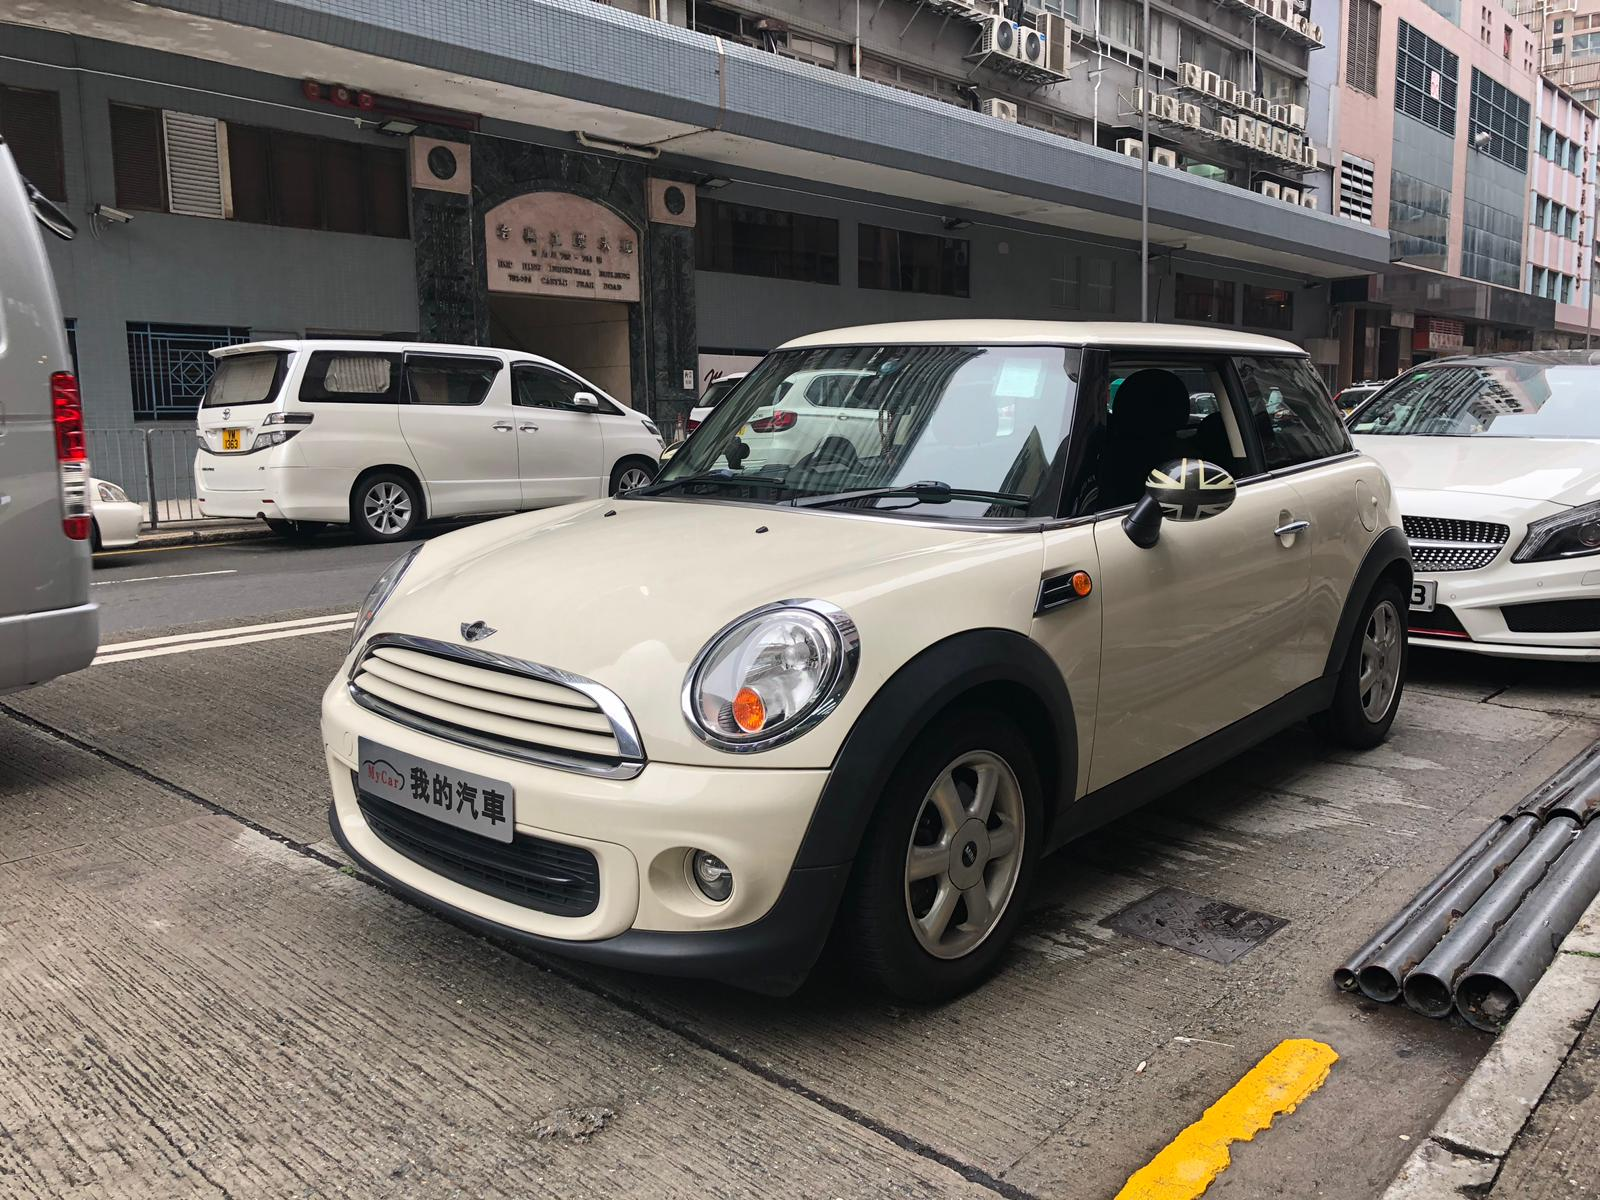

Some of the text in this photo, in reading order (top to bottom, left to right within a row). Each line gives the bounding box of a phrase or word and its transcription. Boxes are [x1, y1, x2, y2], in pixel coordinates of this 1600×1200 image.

[367, 765, 399, 789] MyCar
[410, 766, 506, 826] 我的汽車
